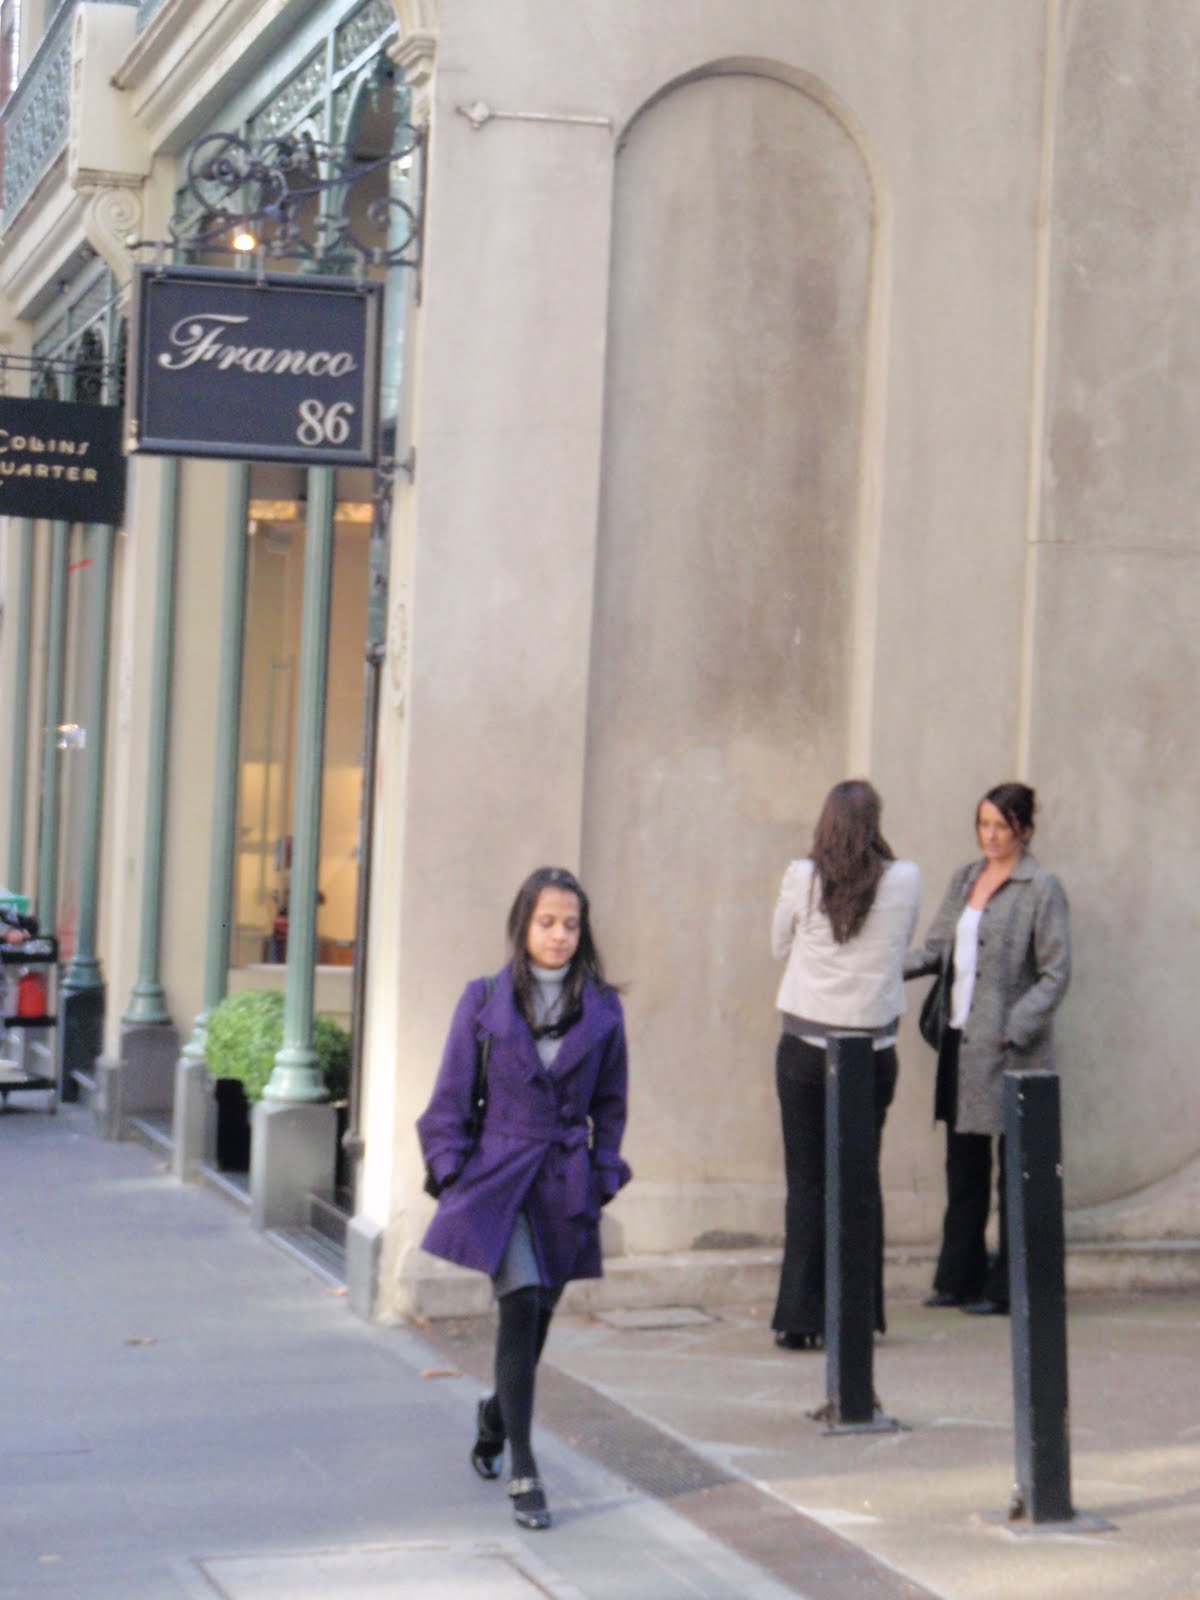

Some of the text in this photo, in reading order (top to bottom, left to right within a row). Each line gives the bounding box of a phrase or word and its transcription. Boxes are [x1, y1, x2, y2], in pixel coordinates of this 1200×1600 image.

[158, 313, 356, 377] Franco
[296, 399, 354, 445] 86
[0, 461, 98, 483] UARTER
